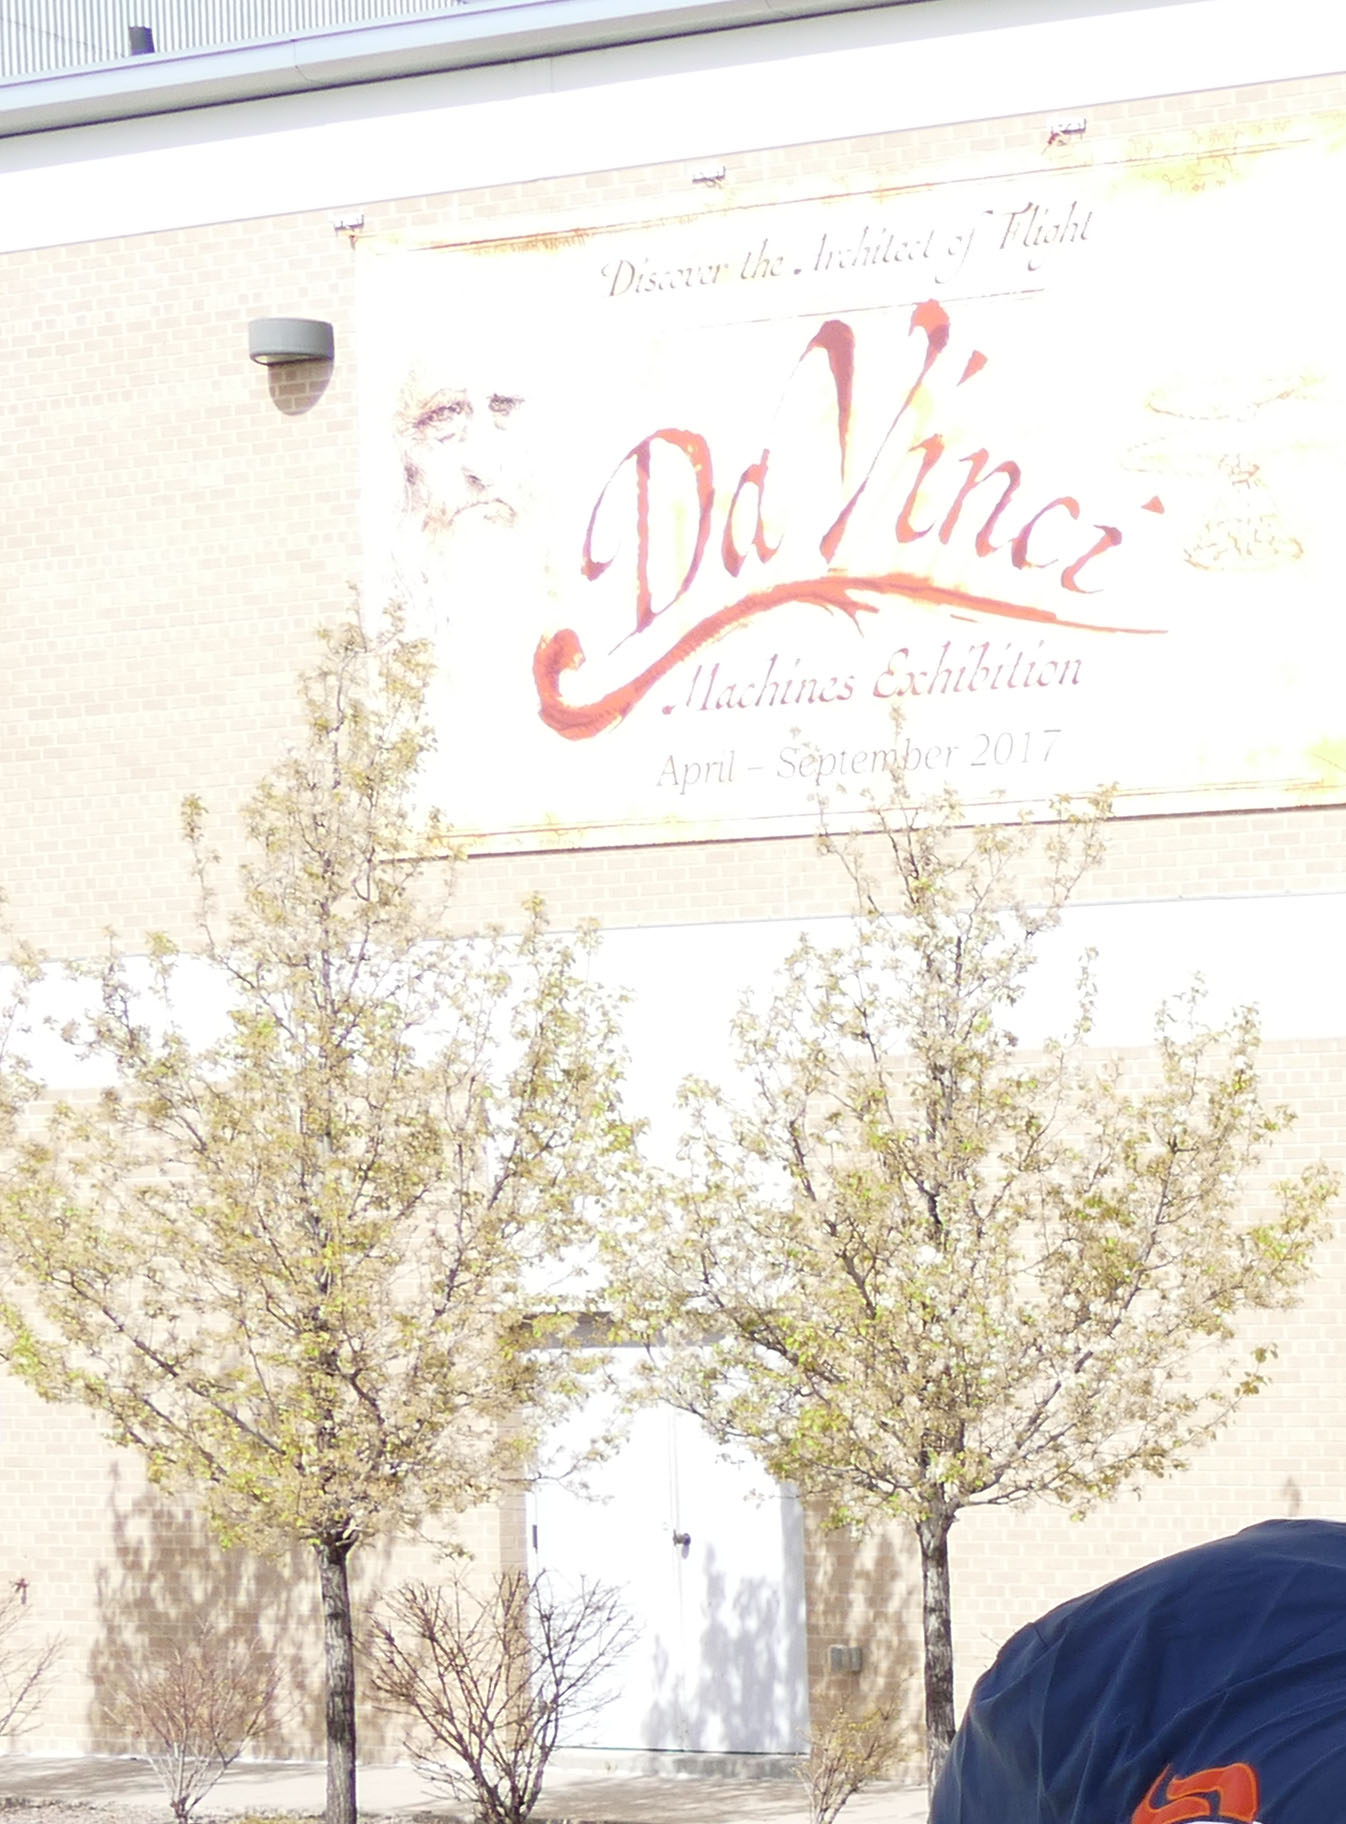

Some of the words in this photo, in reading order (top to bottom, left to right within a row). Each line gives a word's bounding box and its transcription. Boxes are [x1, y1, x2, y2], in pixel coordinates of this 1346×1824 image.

[599, 256, 731, 298] Discover
[739, 237, 785, 280] the
[790, 224, 937, 278] Architect
[933, 208, 995, 285] of
[997, 199, 1095, 272] Flight
[580, 426, 784, 656] Da
[780, 297, 1165, 594] Vinci
[660, 651, 858, 716] Machines
[871, 637, 1086, 701] Exhibition
[656, 748, 738, 797] April
[776, 737, 961, 787] September
[969, 728, 1064, 769] 2017
